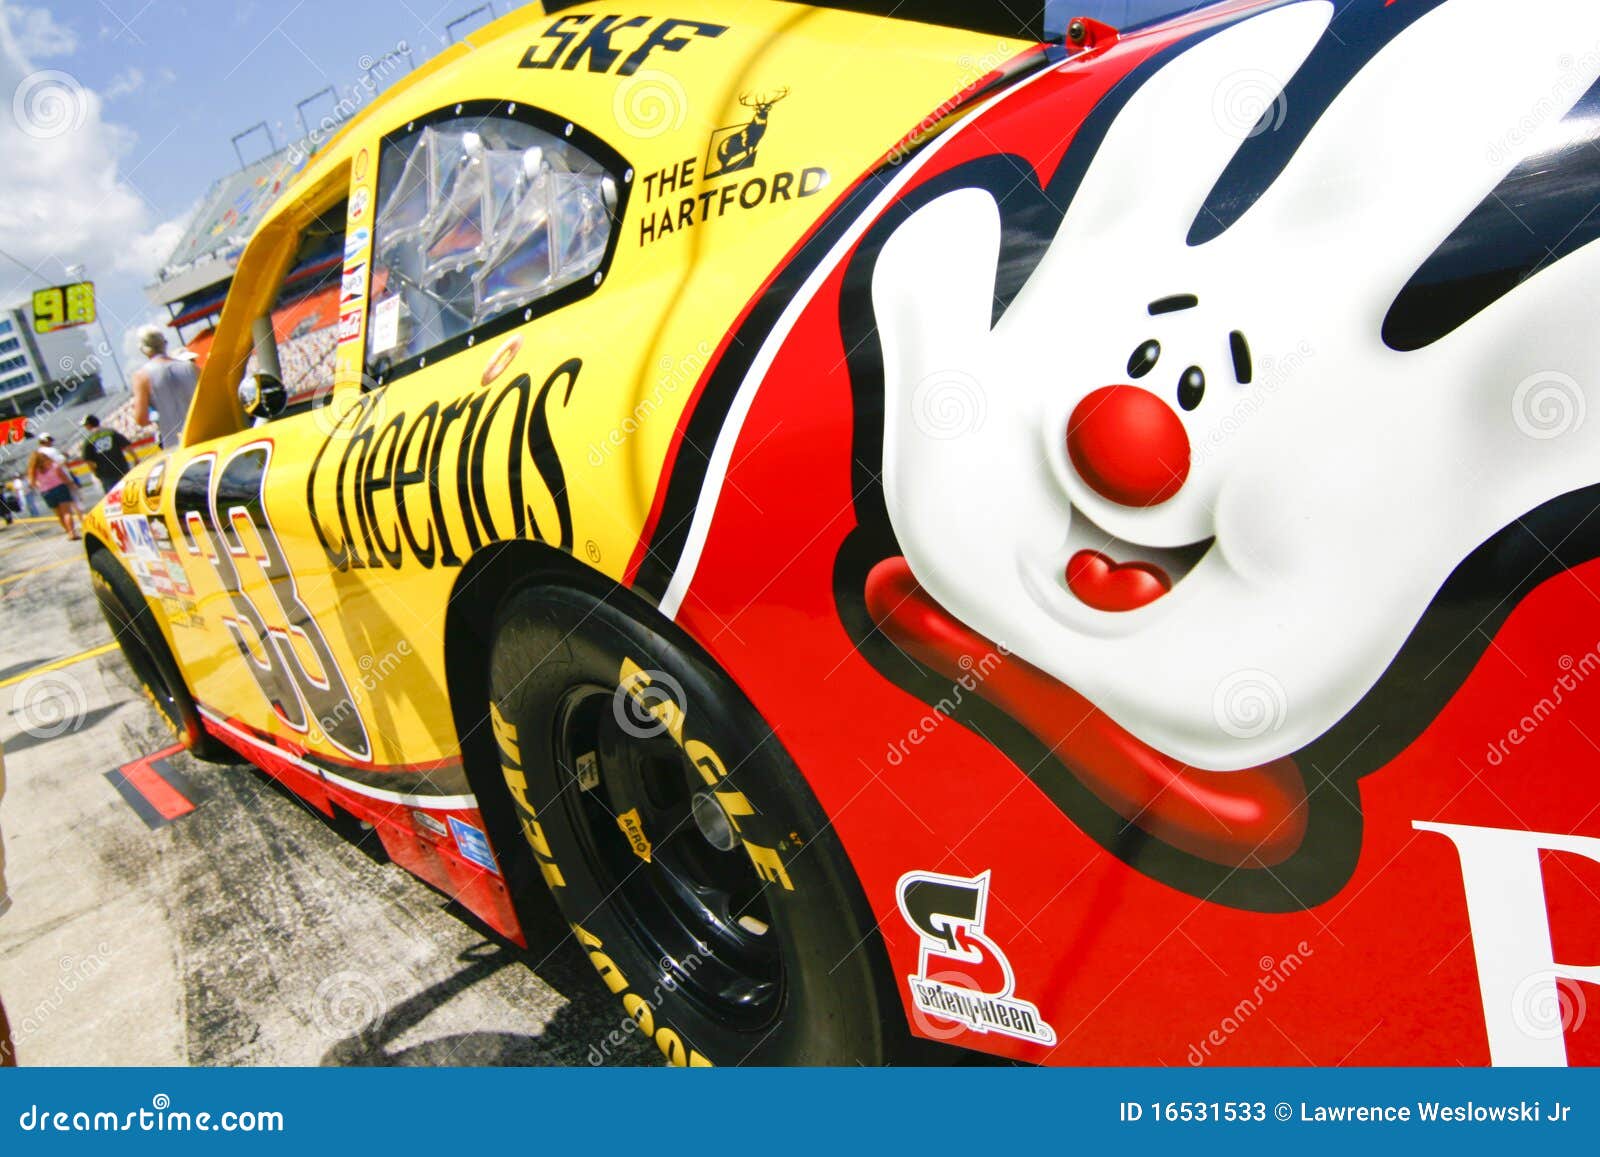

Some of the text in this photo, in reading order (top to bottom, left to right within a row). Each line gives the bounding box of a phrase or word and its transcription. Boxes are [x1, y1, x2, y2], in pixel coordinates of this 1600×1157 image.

[517, 14, 731, 77] SKF
[639, 166, 831, 248] HARTFORD
[642, 155, 698, 204] THE
[33, 282, 96, 334] 98
[306, 335, 583, 573] Cheerios
[173, 438, 373, 763] 33
[489, 701, 567, 887] YEAR
[619, 656, 795, 891] EAGLE
[624, 818, 648, 853] AERO
[917, 983, 1037, 1034] safety-kleen
